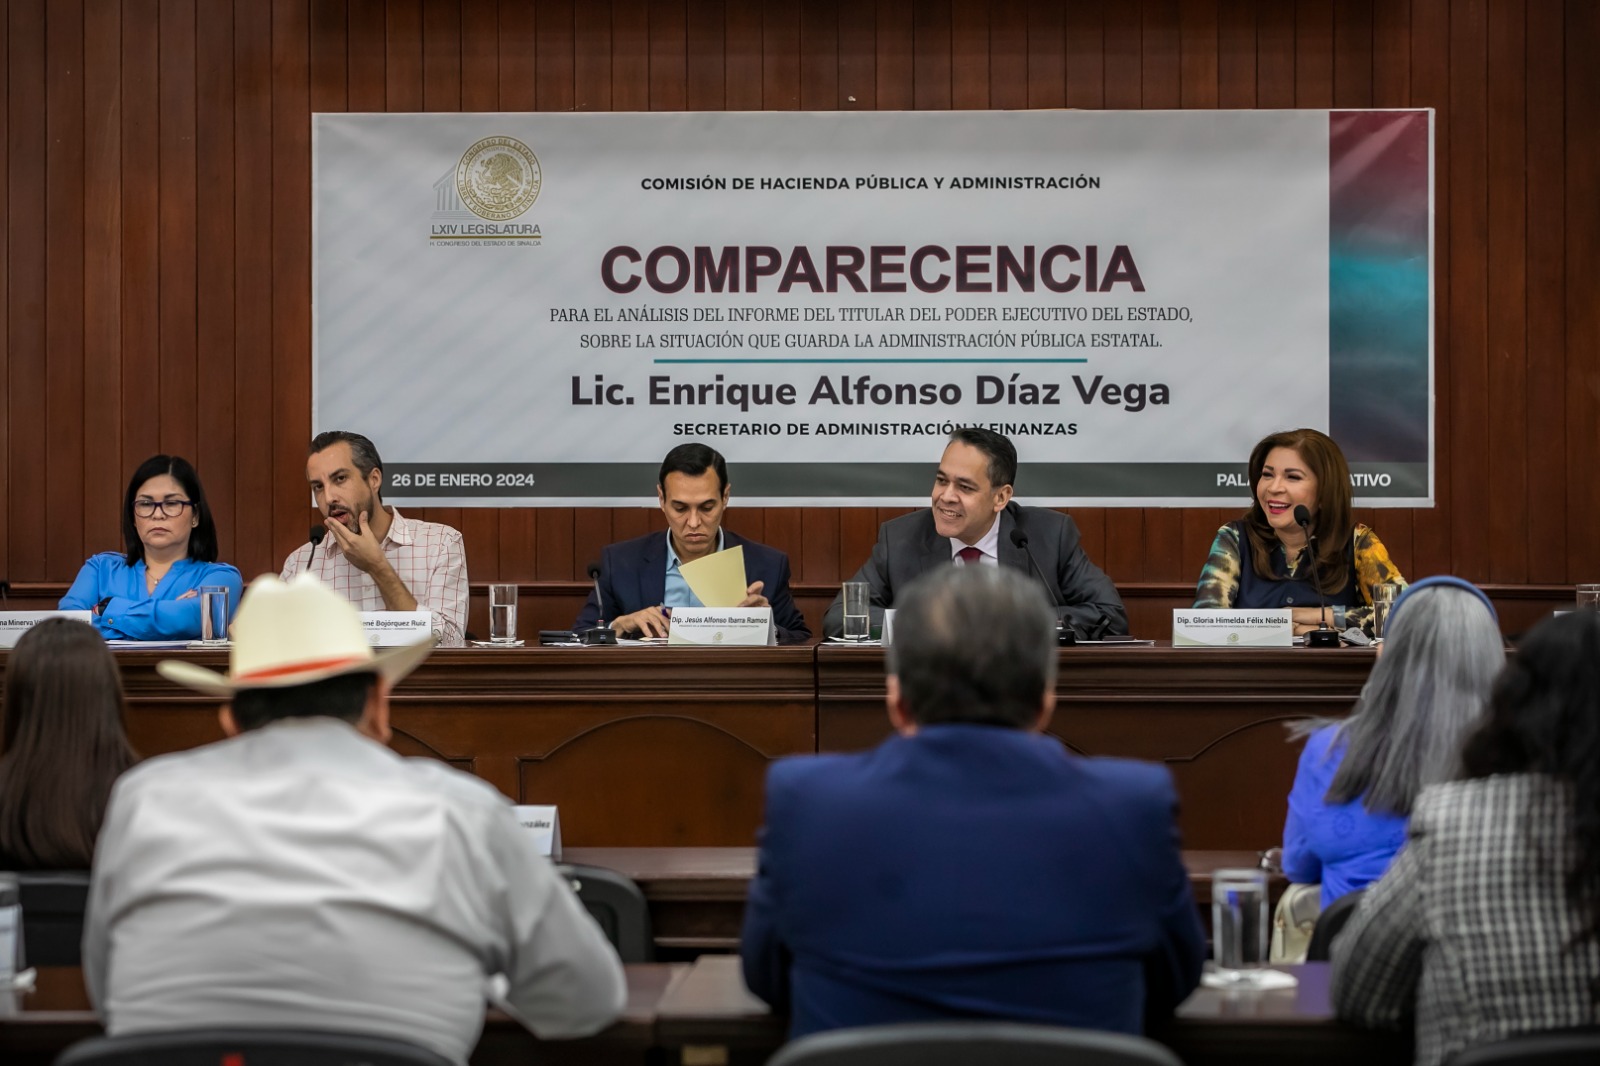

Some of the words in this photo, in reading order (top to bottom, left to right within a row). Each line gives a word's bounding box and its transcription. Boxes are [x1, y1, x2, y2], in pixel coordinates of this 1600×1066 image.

[462, 138, 496, 166] CONGRESO
[498, 138, 512, 146] DEL
[512, 141, 536, 165] ESTADO
[641, 174, 727, 190] COMISIÓN
[733, 178, 755, 190] DE
[761, 177, 850, 190] HACIENDA
[856, 174, 929, 190] PÚBLICA
[934, 177, 945, 190] Y
[950, 173, 1101, 190] ADMINISTRACIÓN
[459, 179, 470, 200] LIBRE
[471, 204, 511, 219] SOBERANO
[512, 207, 522, 216] DE
[521, 179, 539, 209] SINALOA
[431, 224, 458, 235] LXIV
[461, 224, 541, 235] LEGISLATURA
[600, 244, 1146, 295] COMPARECENCIA
[550, 307, 590, 322] PARA
[594, 307, 613, 322] EL
[617, 303, 688, 322] ANÁLISIS
[693, 307, 724, 322] DEL
[728, 307, 799, 322] INFORME
[804, 307, 834, 322] DEL
[839, 307, 905, 322] TITULAR
[910, 307, 940, 322] DEL
[945, 307, 997, 322] PODER
[1003, 307, 1087, 322] EJECUTIVO
[1092, 307, 1123, 322] DEL
[1128, 307, 1193, 323] ESTADO,
[581, 334, 631, 348] SOBRE
[636, 334, 655, 348] LA
[660, 330, 743, 348] SITUACIÓN
[748, 334, 780, 350] QUE
[785, 334, 850, 348] GUARDA
[855, 334, 874, 348] LA
[879, 330, 1016, 348] ADMINISTRACIÓN
[1021, 330, 1086, 348] PÚBLICA
[1091, 334, 1163, 348] ESTATAL.
[572, 374, 635, 405] Lic.
[650, 374, 797, 413] Enrique
[808, 373, 962, 405] Alfonso
[977, 373, 1061, 405] Díaz
[1072, 375, 1170, 412] Vega
[673, 422, 781, 436] SECRETARIO
[787, 422, 810, 436] DE
[989, 423, 1078, 436] FINANZAS
[392, 473, 410, 487] 26
[415, 473, 436, 487] DE
[440, 473, 493, 487] ENERO
[497, 473, 535, 487] 2024
[1216, 473, 1251, 487] PAL
[8, 618, 34, 626] Minerva
[361, 619, 375, 627] ené
[376, 619, 410, 628] Bojórquez
[411, 619, 426, 627] Ruiz
[672, 616, 684, 625] Dip.
[685, 616, 703, 624] Jesús
[704, 616, 727, 624] Alfonso
[728, 616, 745, 624] Ibarra
[747, 616, 768, 624] Ramos
[1177, 616, 1191, 625] Dip.
[1193, 616, 1214, 624] Gloria
[1216, 616, 1245, 624] Himelda
[1247, 616, 1264, 624] Félix
[1266, 616, 1288, 624] Niebla
[519, 819, 550, 828] nzález
